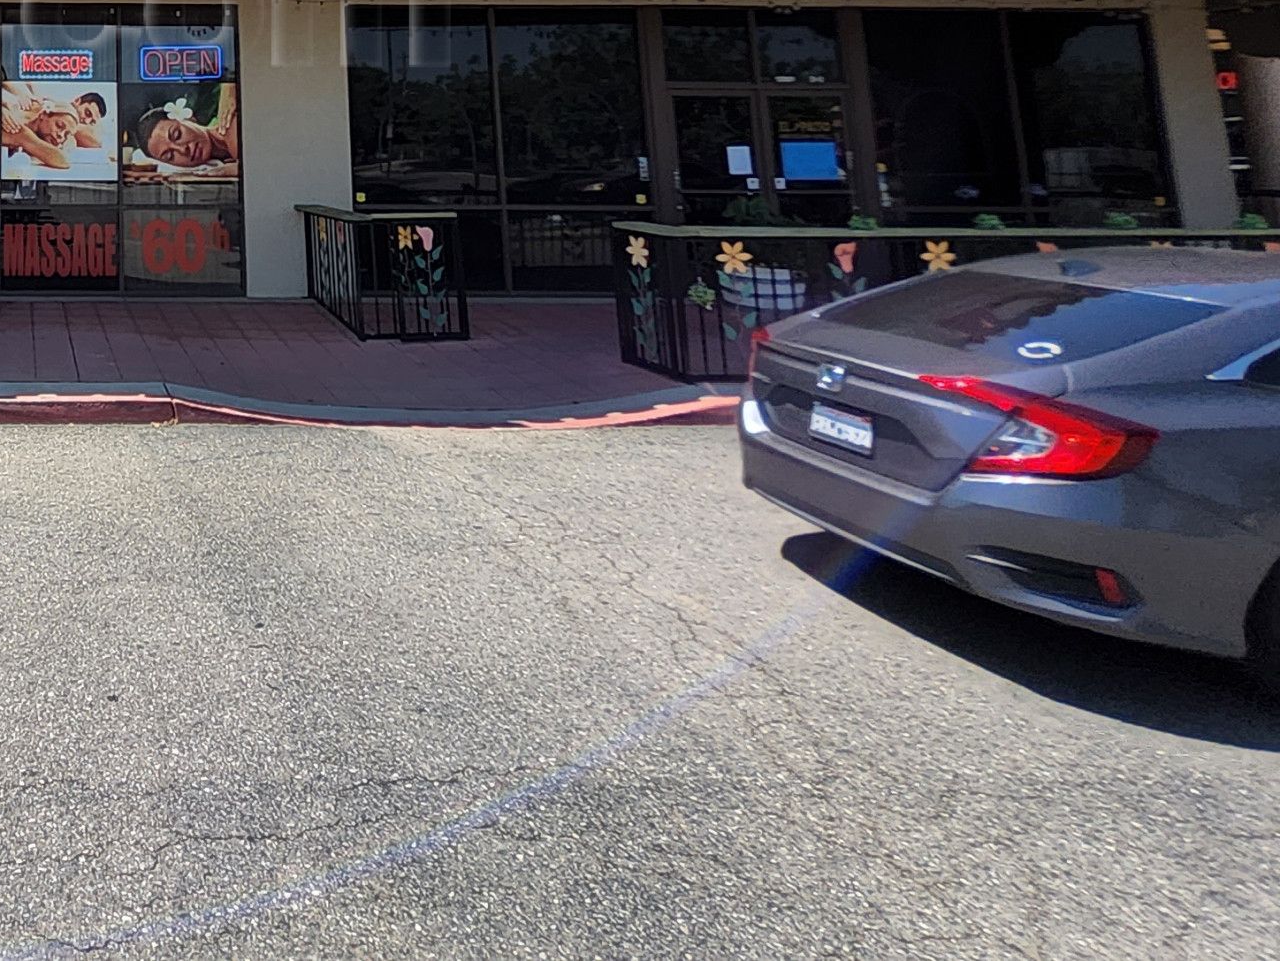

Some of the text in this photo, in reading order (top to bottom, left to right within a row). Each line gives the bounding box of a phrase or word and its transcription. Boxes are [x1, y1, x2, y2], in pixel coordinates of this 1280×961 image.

[22, 54, 90, 77] Massage
[144, 49, 218, 77] OPEN
[3, 223, 118, 277] MASSAGE
